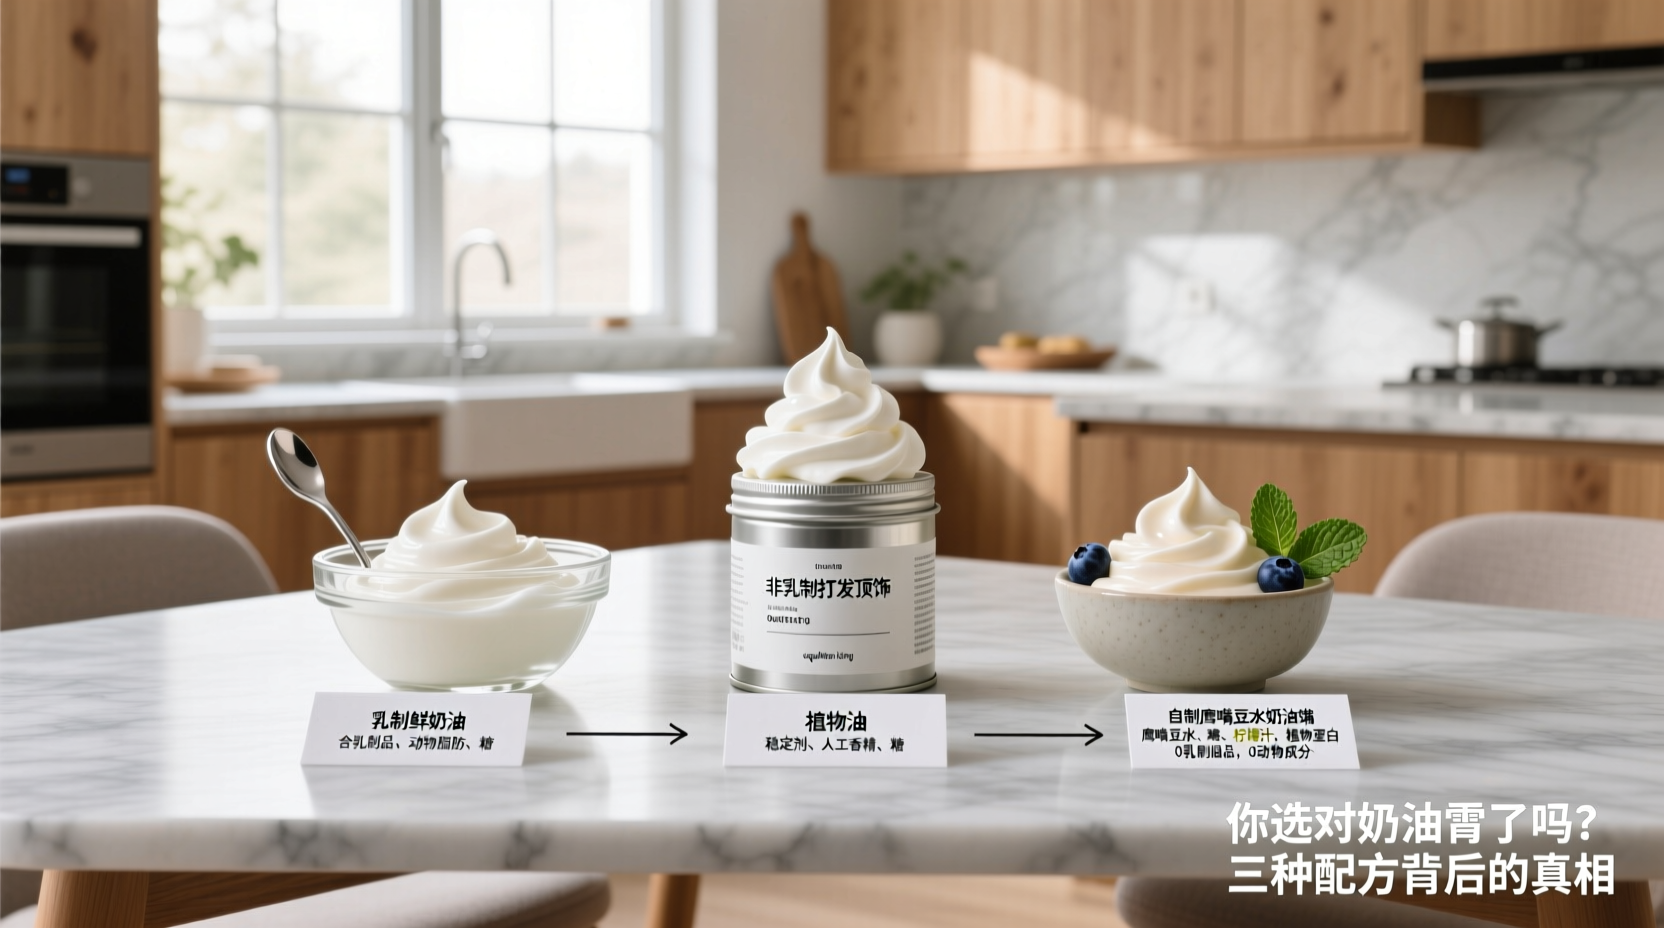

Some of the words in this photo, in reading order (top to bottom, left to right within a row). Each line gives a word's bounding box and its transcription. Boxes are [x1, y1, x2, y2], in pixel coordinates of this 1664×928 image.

[765, 576, 891, 599] 非乳制打发顶饰
[371, 710, 467, 731] 乳制鲜奶油
[804, 710, 867, 732] 植物油
